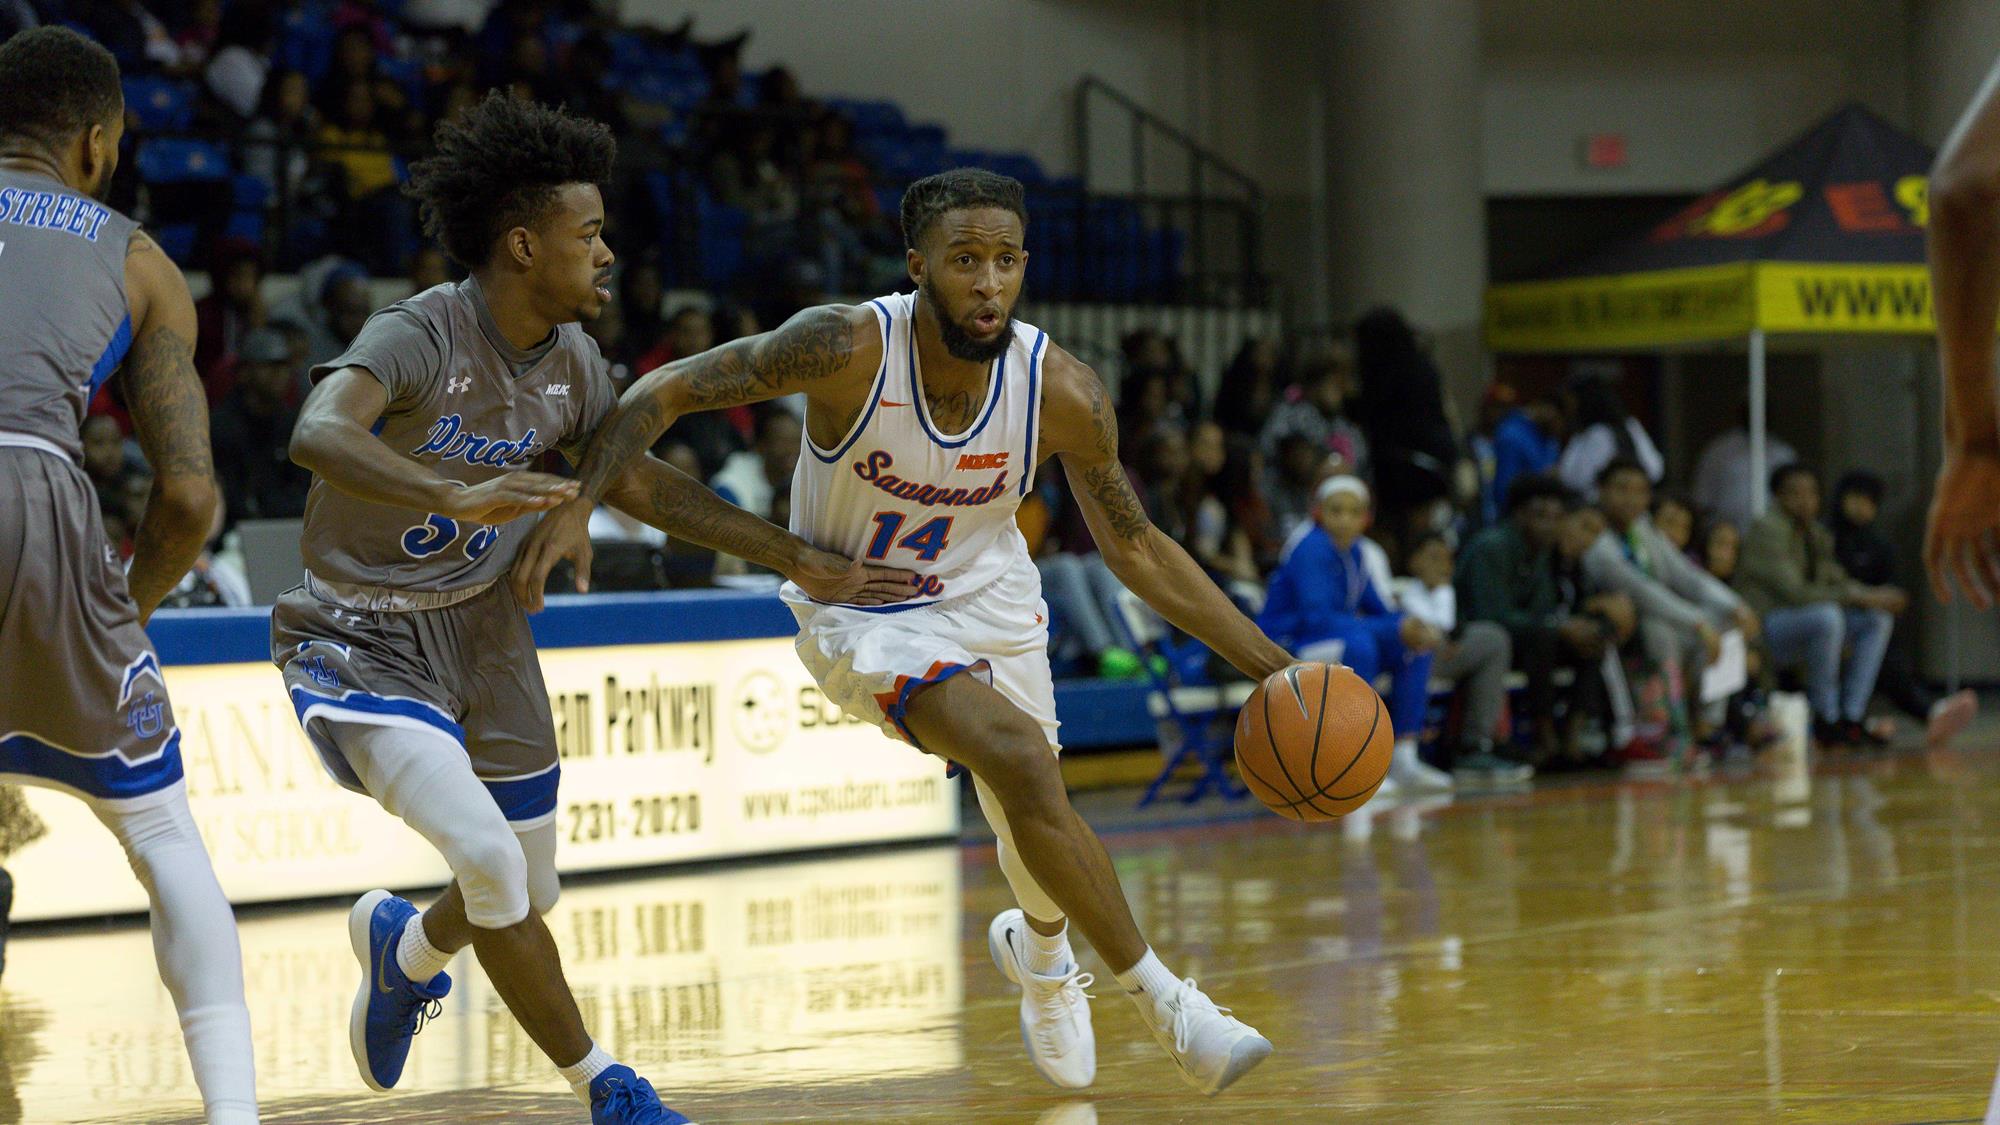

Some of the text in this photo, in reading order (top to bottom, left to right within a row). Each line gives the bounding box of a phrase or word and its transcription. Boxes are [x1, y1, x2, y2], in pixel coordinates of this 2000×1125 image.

[0, 187, 111, 242] STREET
[410, 413, 544, 468] Pirat
[853, 450, 1009, 507] Savannah
[866, 511, 955, 561] 14
[605, 671, 717, 766] Parkway
